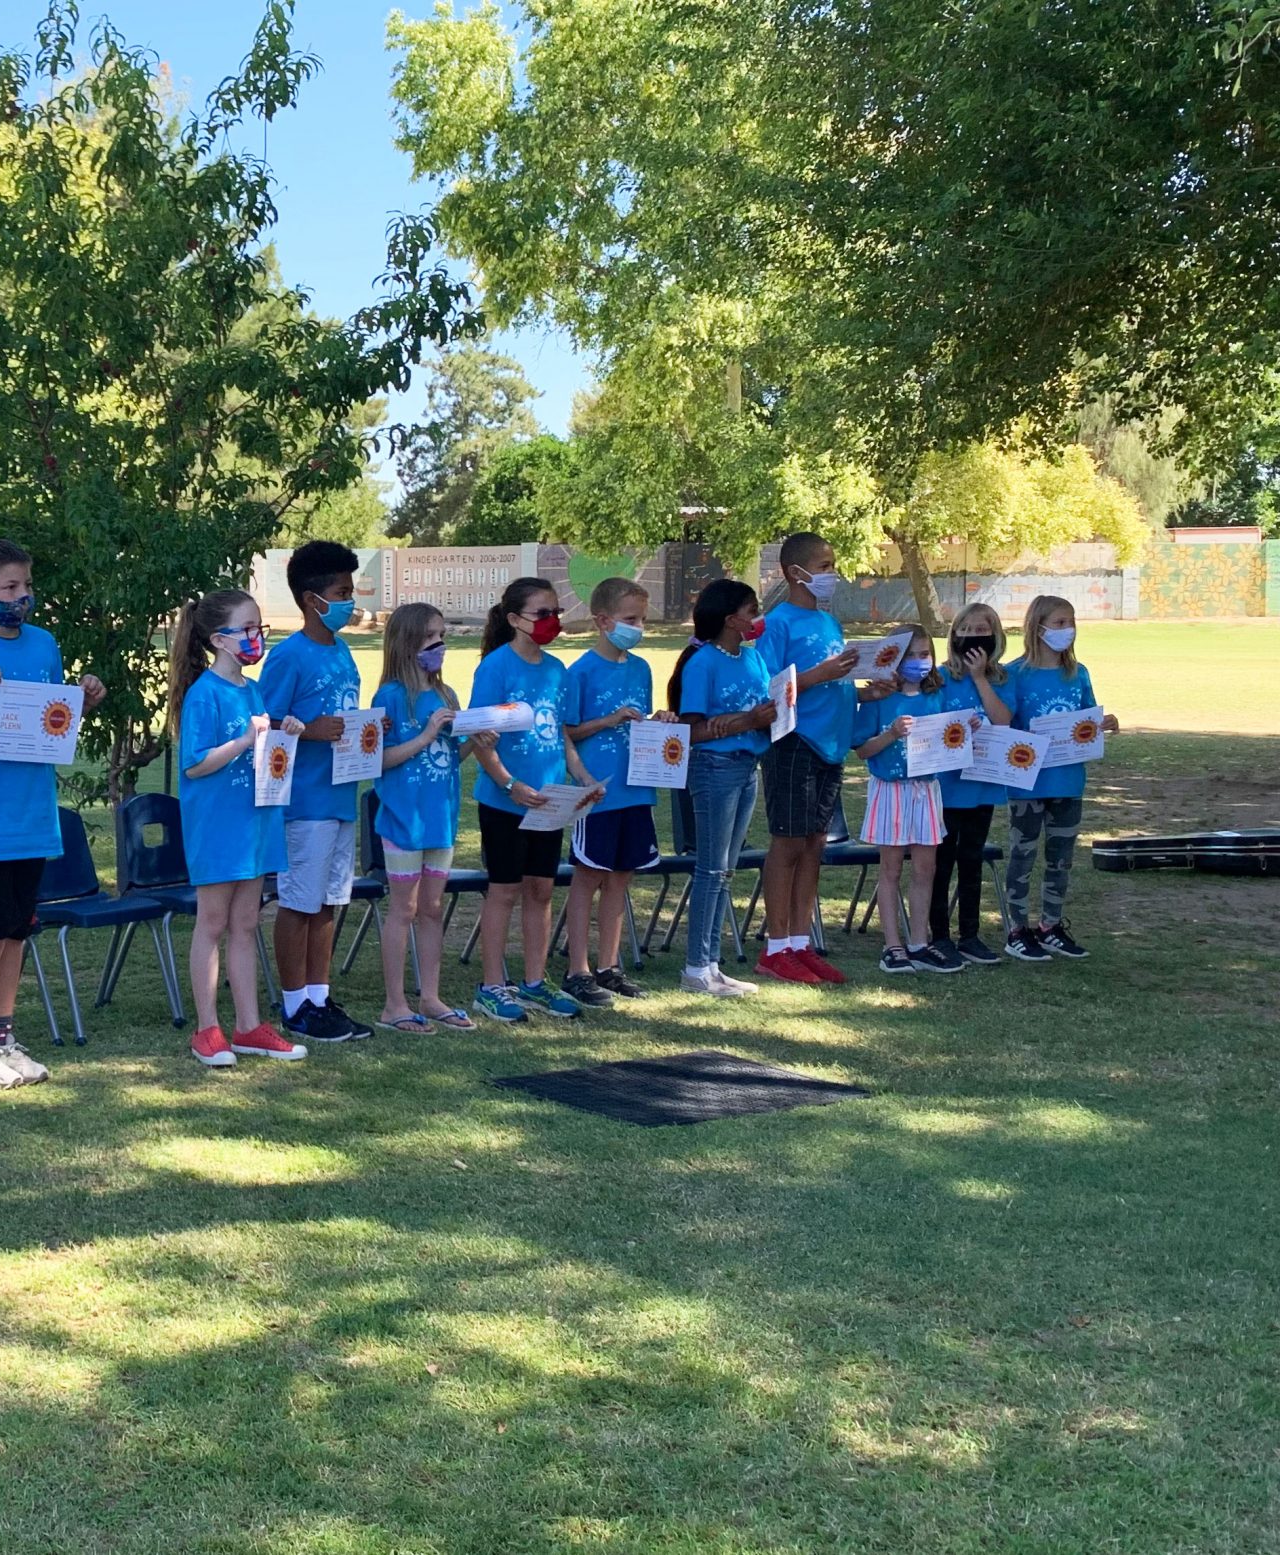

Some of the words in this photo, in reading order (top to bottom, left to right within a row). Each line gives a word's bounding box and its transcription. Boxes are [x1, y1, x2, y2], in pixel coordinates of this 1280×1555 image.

[408, 554, 475, 564] KINDERGARTEN
[479, 554, 516, 563] 2006-2007
[1, 713, 18, 721] JACK
